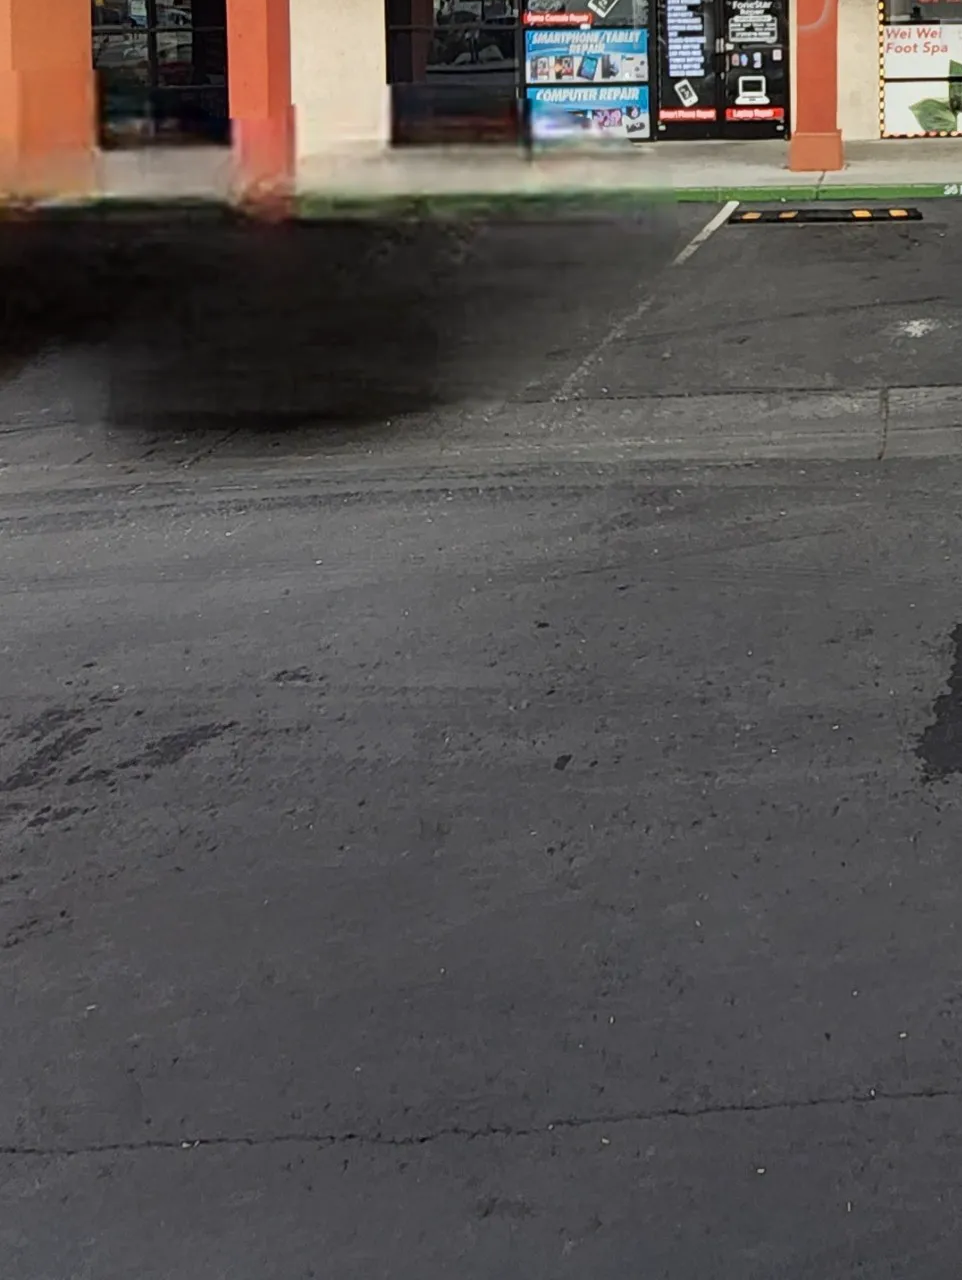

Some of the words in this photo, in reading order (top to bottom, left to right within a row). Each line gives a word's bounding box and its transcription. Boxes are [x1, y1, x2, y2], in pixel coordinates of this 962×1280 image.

[886, 27, 911, 39] Wei
[917, 27, 942, 38] Wei
[886, 41, 918, 53] Foot
[923, 41, 949, 55] Spa
[536, 88, 598, 101] COMPUTER
[600, 87, 640, 100] REPAIR
